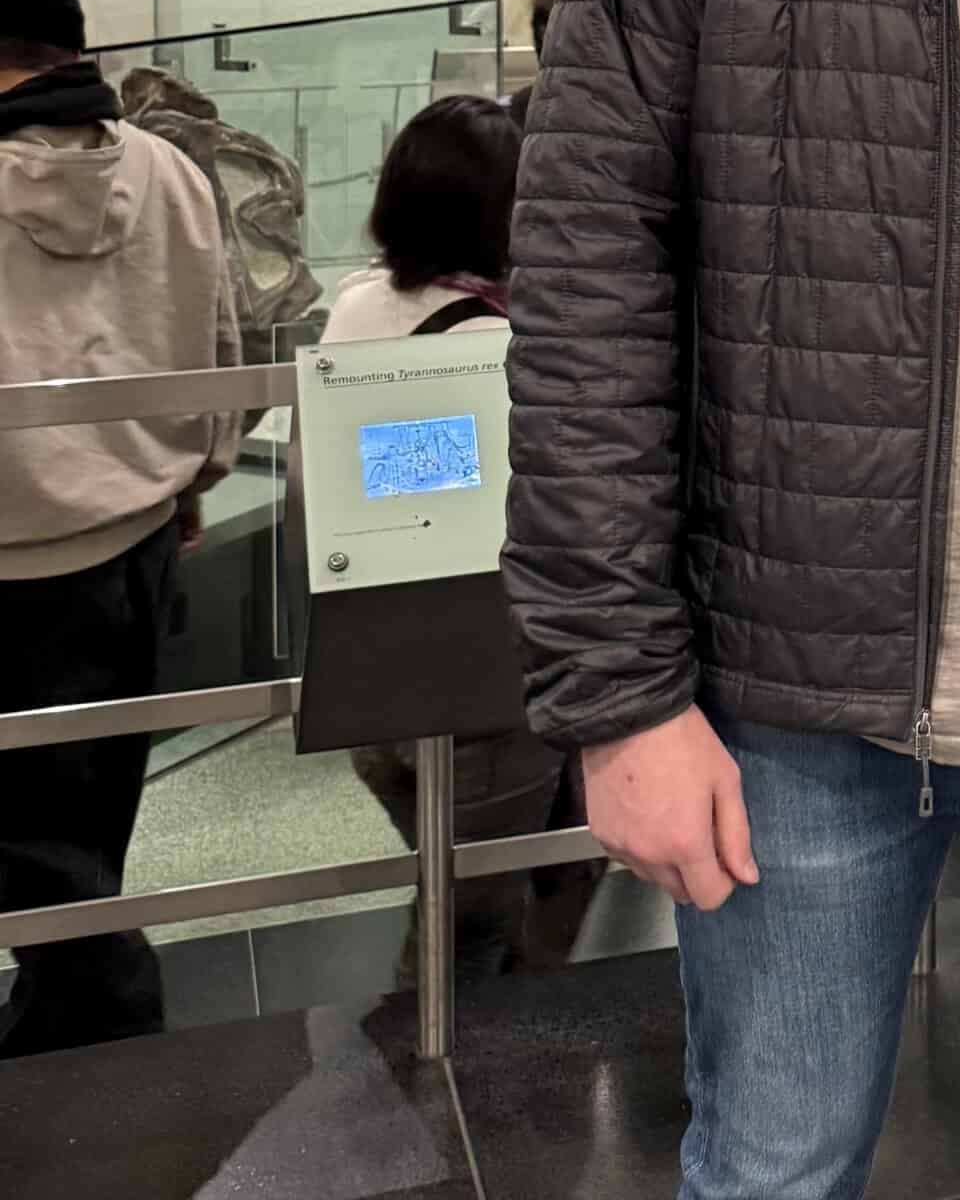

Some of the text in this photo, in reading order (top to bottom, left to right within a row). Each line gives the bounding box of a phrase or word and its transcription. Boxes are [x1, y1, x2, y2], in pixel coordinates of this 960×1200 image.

[323, 362, 499, 385] Remounting Tyrannosaurus rex
